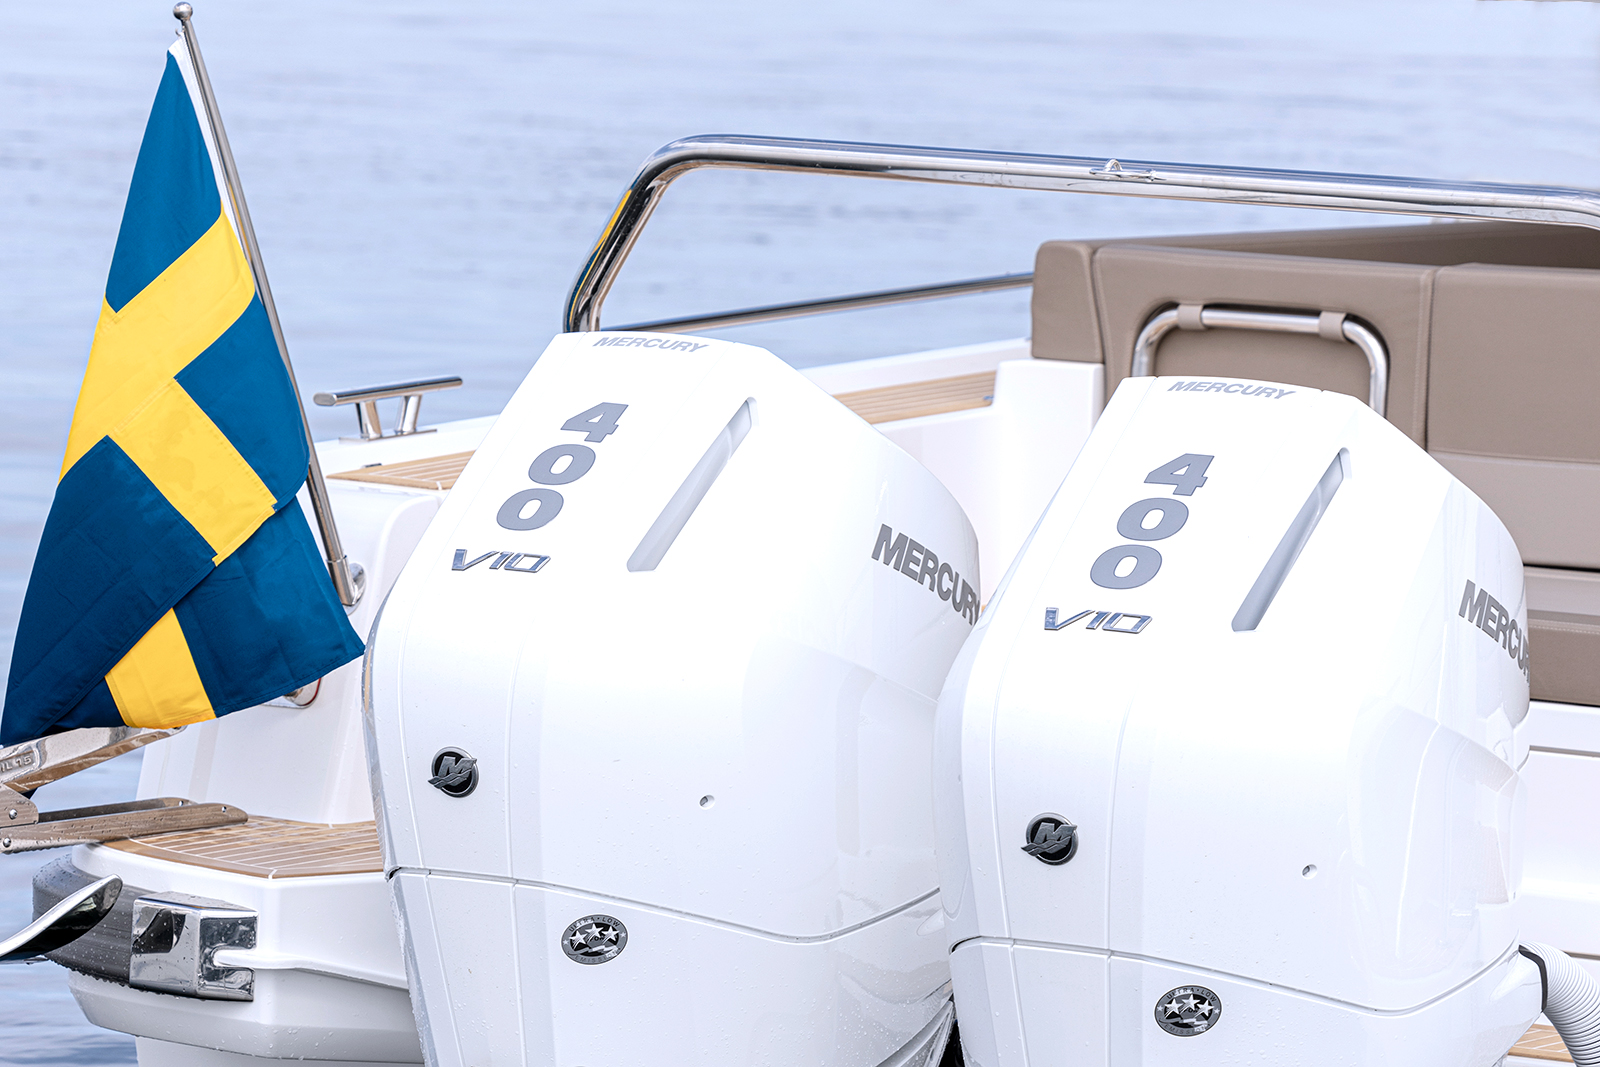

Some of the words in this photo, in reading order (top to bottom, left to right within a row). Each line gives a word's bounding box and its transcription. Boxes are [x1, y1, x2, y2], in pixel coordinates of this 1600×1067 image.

[592, 336, 710, 353] MERCURY
[1166, 381, 1297, 400] MERCURY
[451, 548, 551, 574] V10
[1044, 606, 1153, 635] V10
[1458, 579, 1530, 687] MERCUR
[602, 916, 621, 928] LOW
[1200, 989, 1218, 1002] LOW
